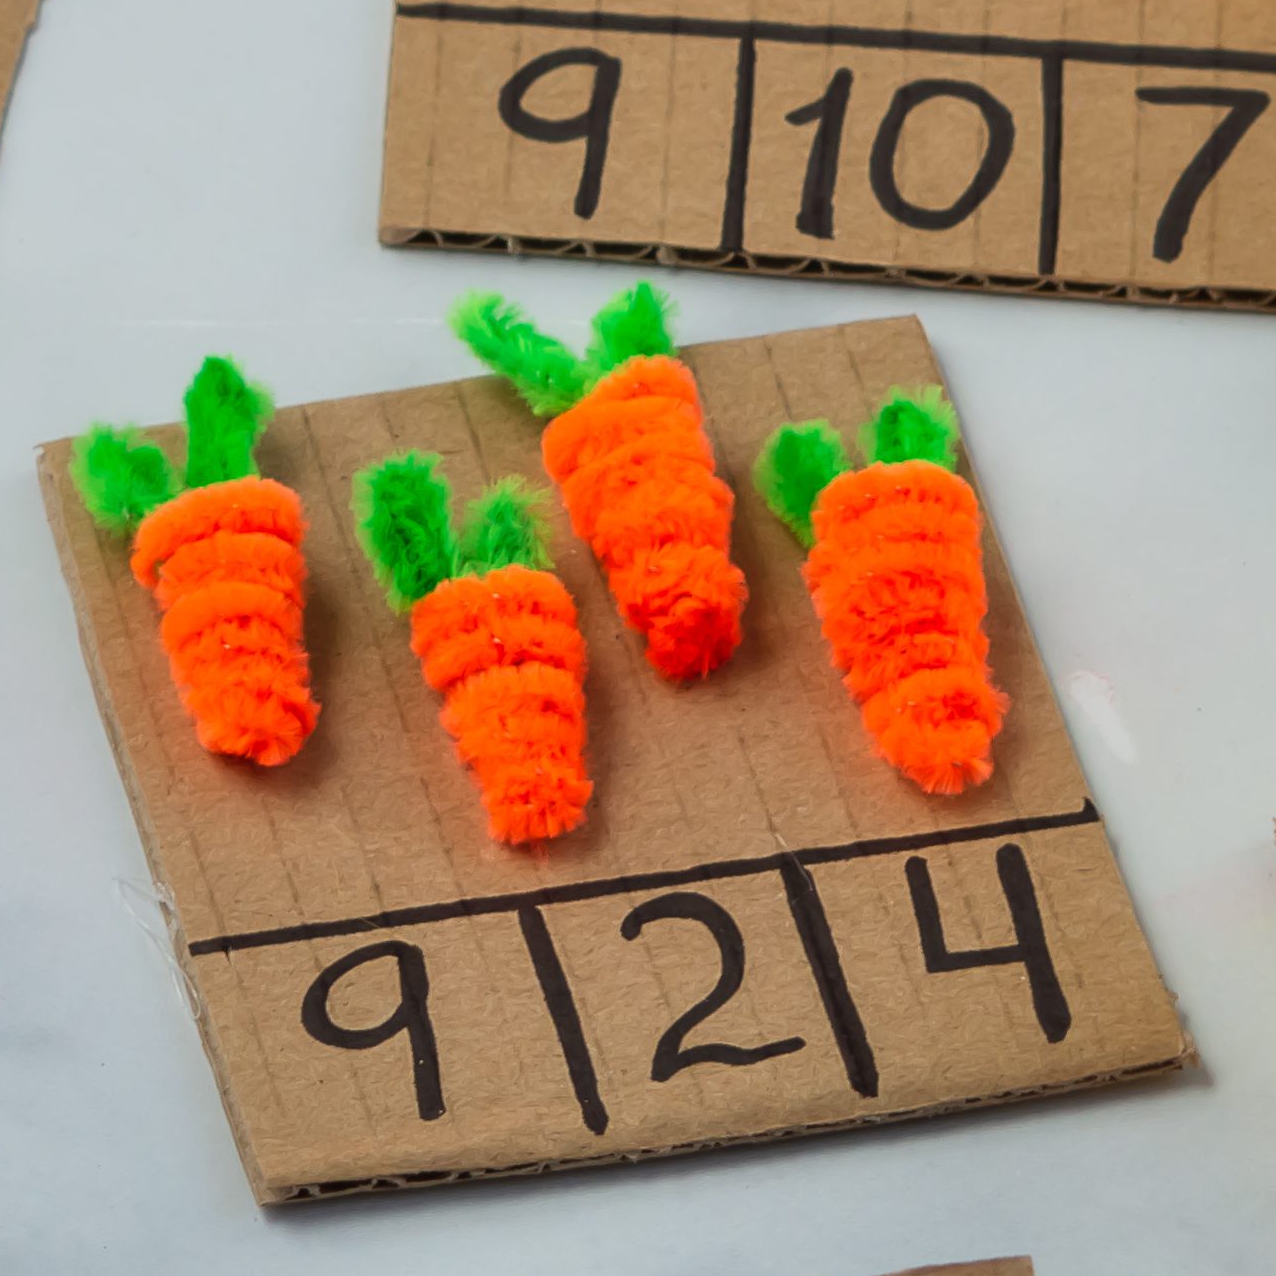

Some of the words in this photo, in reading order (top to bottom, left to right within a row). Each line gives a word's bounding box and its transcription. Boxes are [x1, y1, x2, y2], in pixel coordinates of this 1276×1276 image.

[498, 47, 622, 219] 9
[784, 68, 1015, 238] 10
[1135, 87, 1271, 262] 7
[301, 940, 446, 1121] 9
[620, 892, 806, 1082] 2
[903, 843, 1072, 1044] 4
